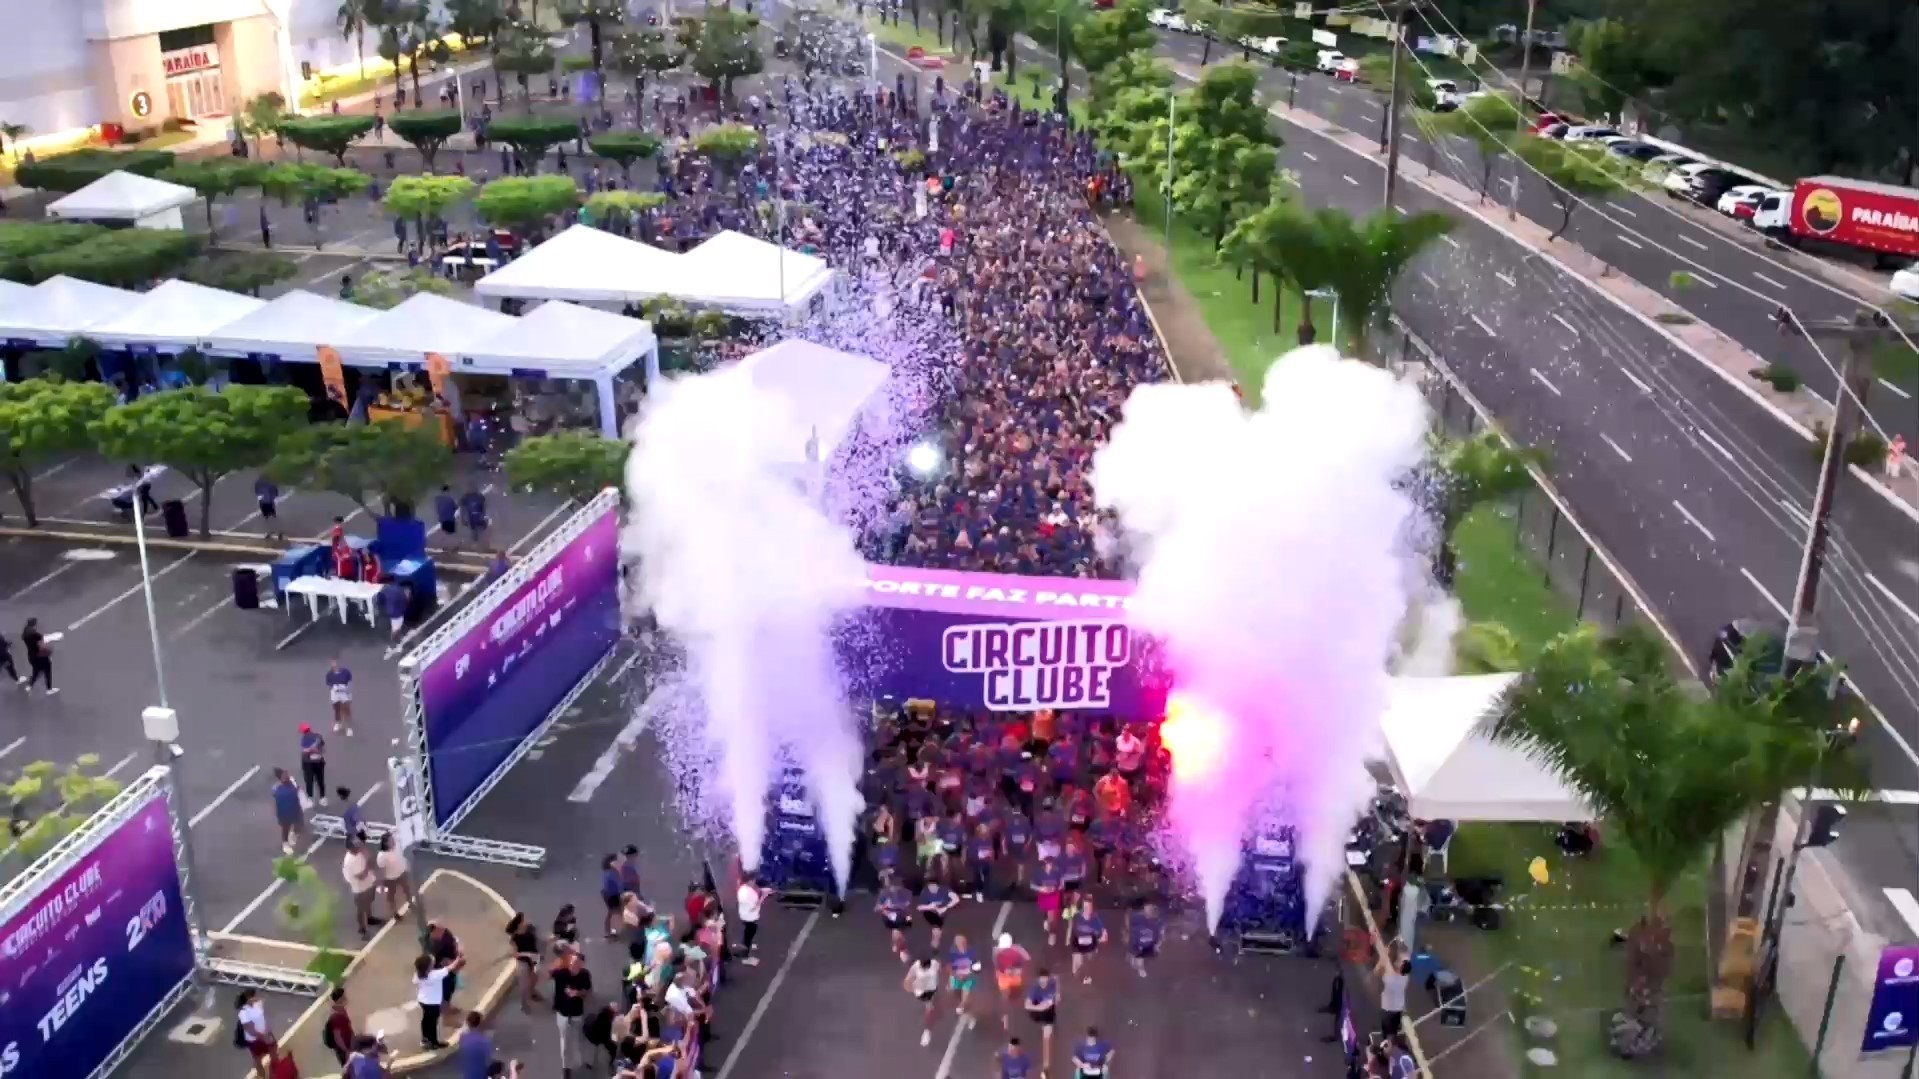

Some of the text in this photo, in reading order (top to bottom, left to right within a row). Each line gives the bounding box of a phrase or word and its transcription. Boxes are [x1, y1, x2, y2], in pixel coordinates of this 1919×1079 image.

[137, 95, 148, 115] 3
[1852, 207, 1919, 233] PARAÍBA
[965, 585, 1029, 604] FAZ
[944, 623, 1130, 671] CIRCUITO
[984, 665, 1112, 711] CLUBE
[2, 893, 63, 956] CIRCUITO
[37, 957, 108, 1042] TEENS
